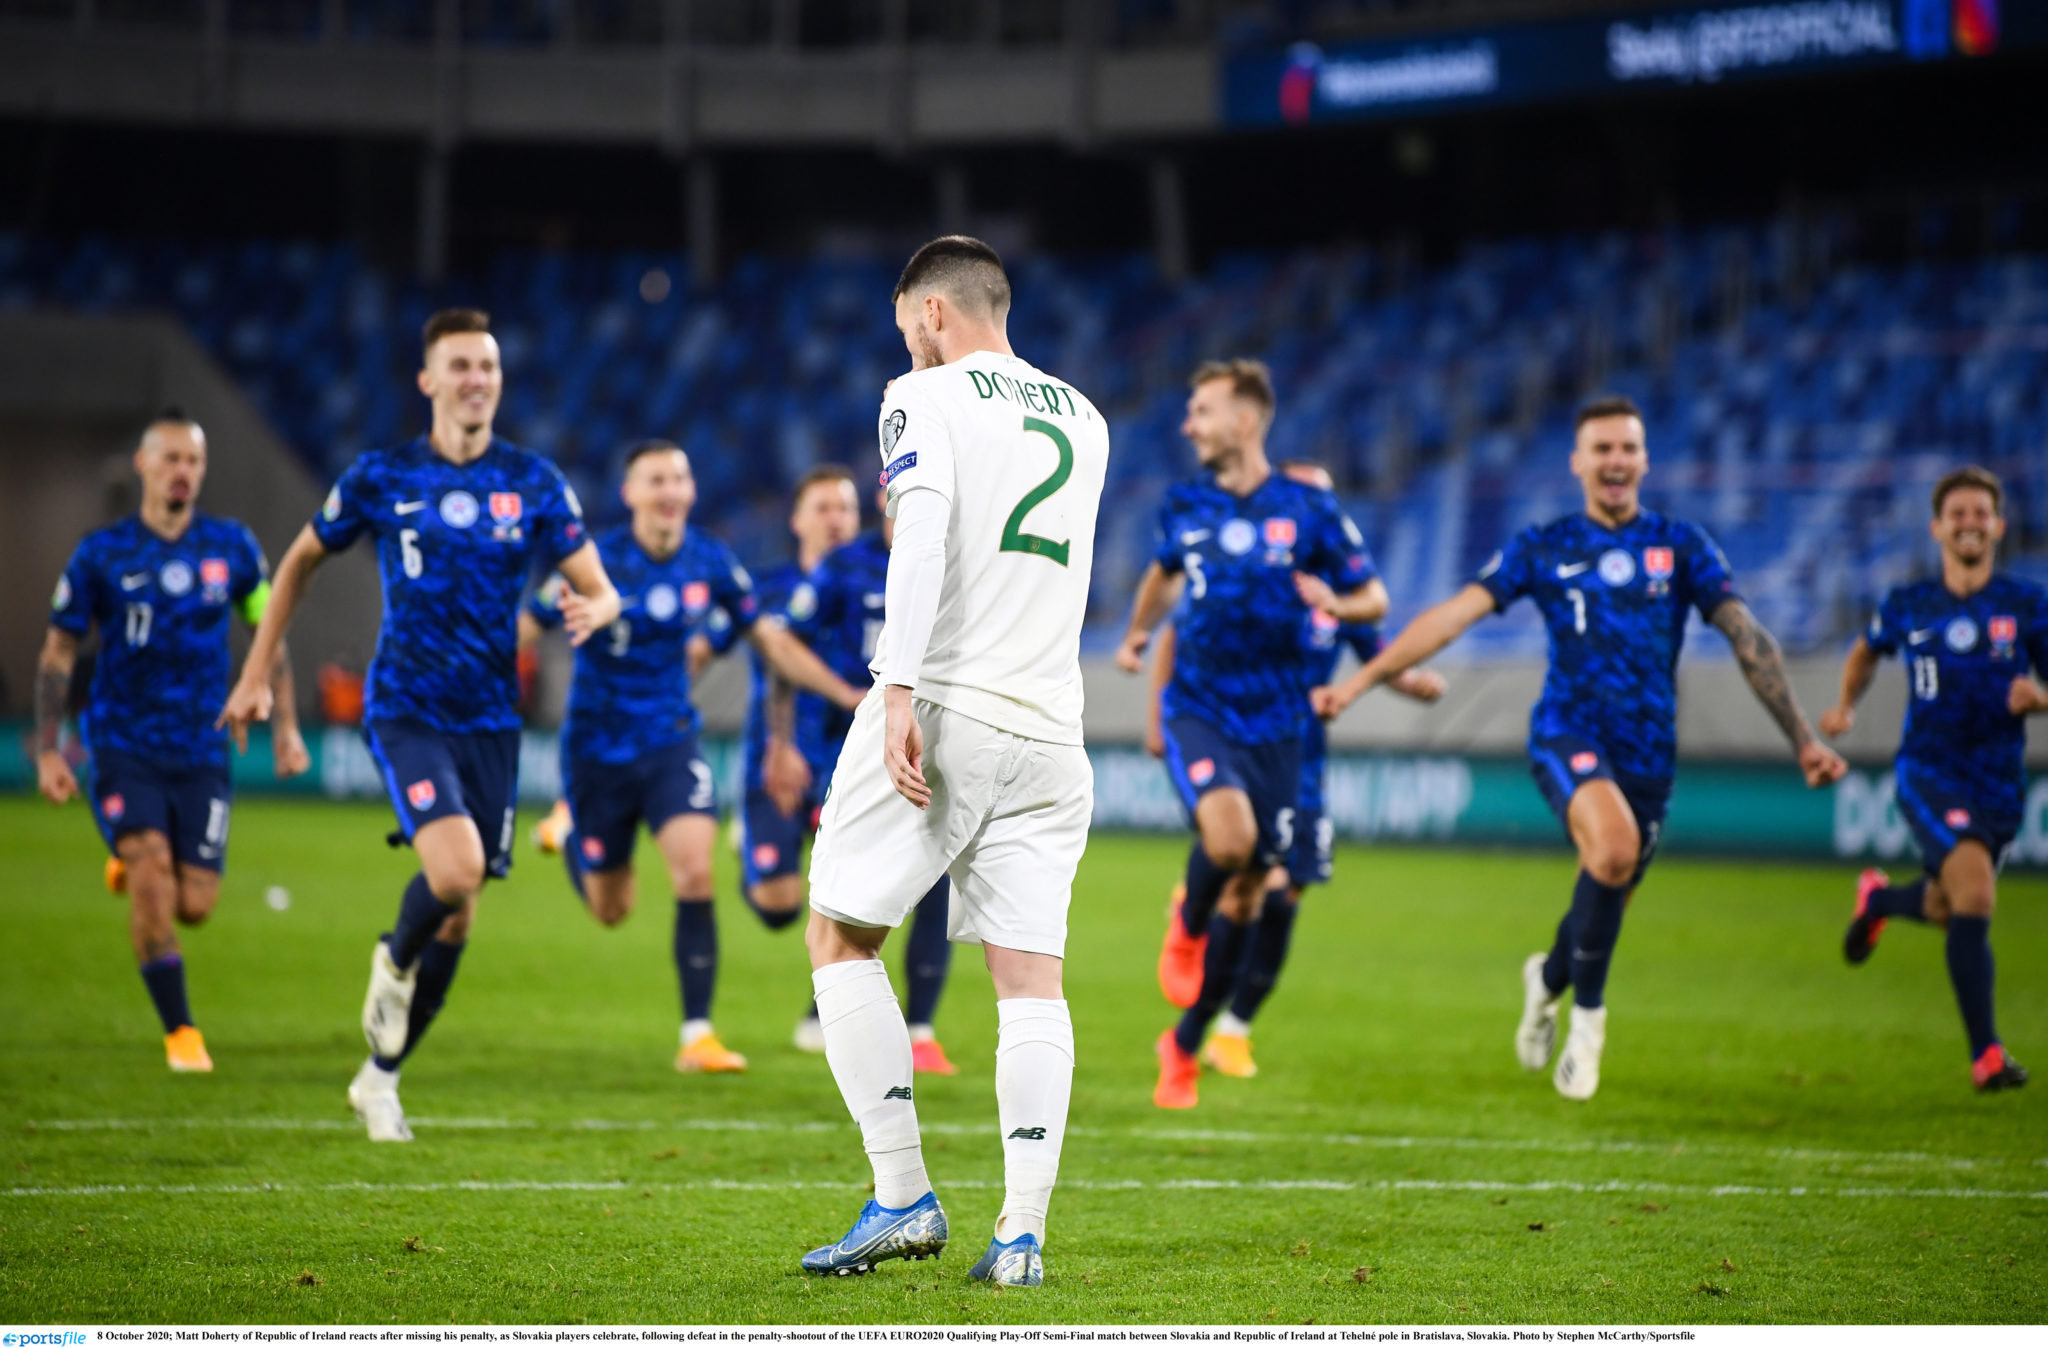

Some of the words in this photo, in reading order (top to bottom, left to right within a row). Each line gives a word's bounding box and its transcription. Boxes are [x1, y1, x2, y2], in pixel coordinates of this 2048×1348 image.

[966, 368, 1092, 421] DOHERT
[888, 455, 917, 479] RESPECT
[999, 415, 1075, 568] 2
[401, 529, 424, 579] 6
[1183, 551, 1208, 600] 5
[1275, 806, 1297, 851] 5
